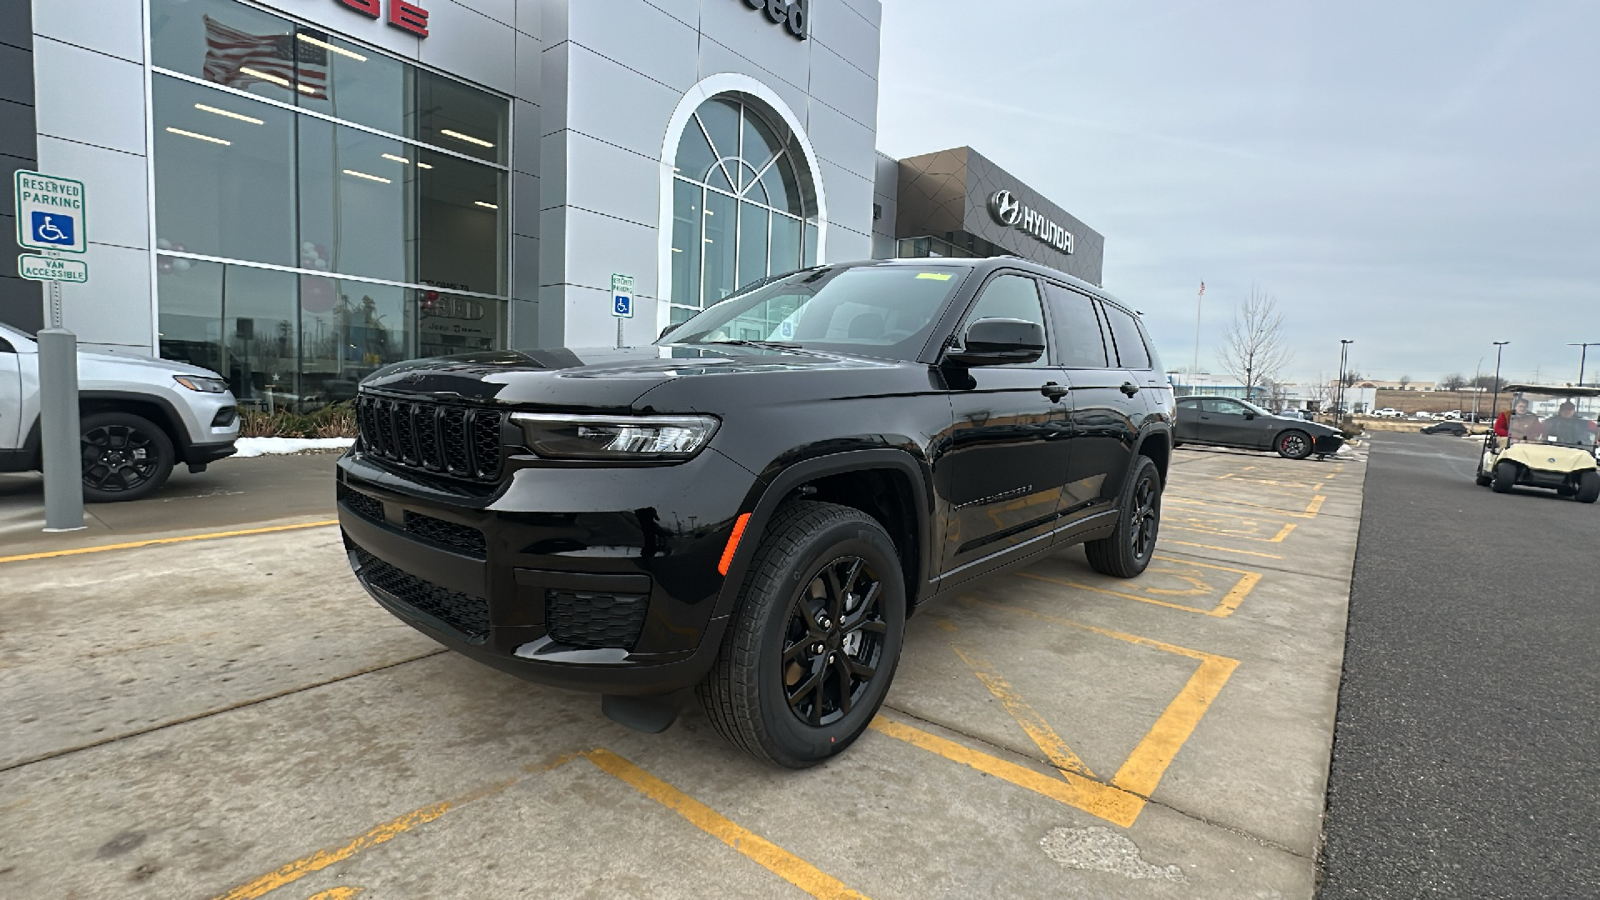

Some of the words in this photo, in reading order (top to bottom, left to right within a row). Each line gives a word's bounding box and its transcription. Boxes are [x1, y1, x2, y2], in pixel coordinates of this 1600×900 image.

[743, 0, 808, 40] ed
[23, 178, 79, 197] RESERVED
[23, 191, 81, 209] PARKING
[1023, 206, 1074, 254] HYUNDAI
[45, 260, 64, 269] VAN
[25, 268, 84, 280] ACCESSIBLE
